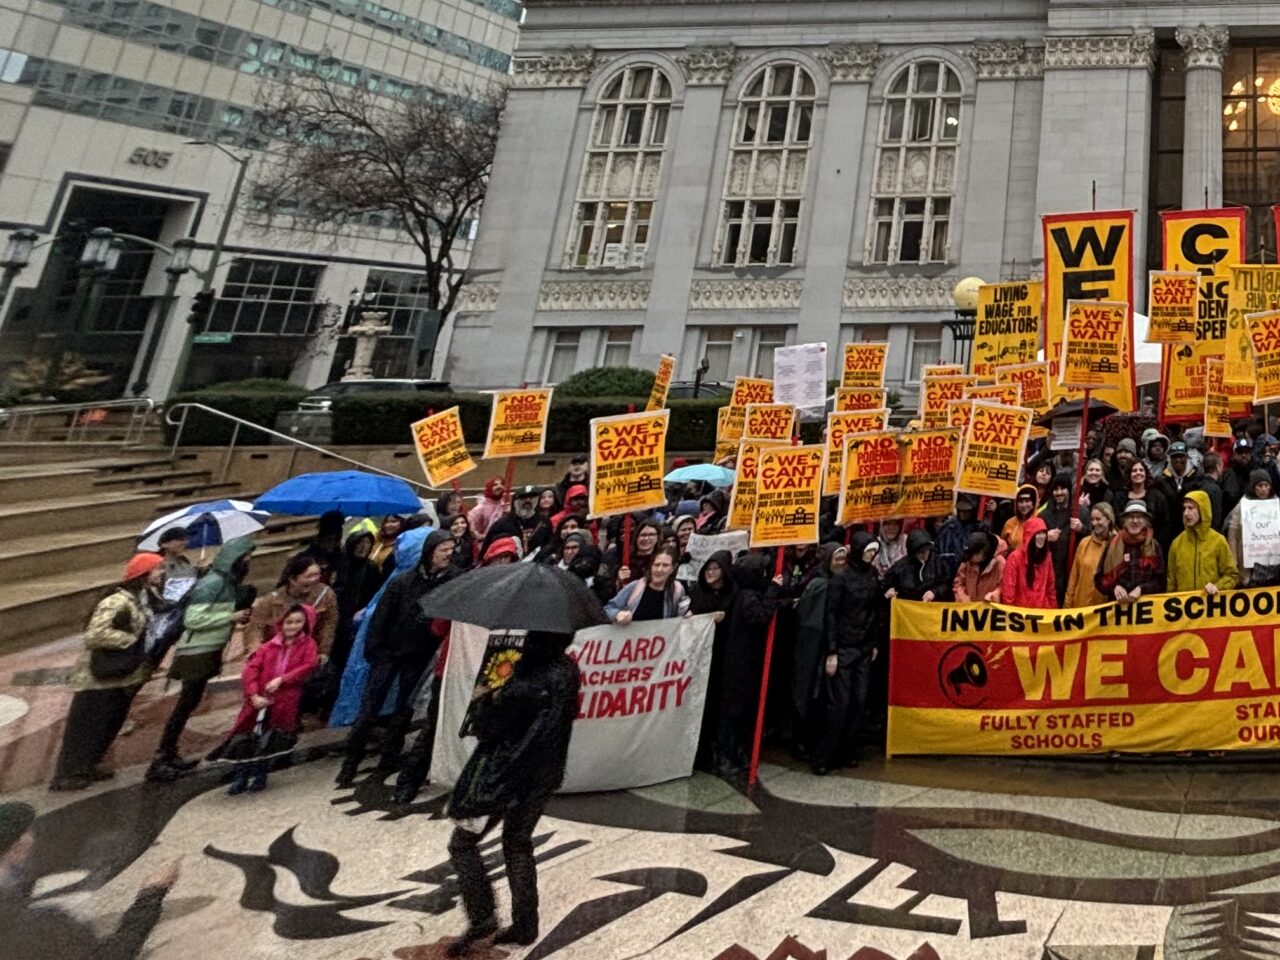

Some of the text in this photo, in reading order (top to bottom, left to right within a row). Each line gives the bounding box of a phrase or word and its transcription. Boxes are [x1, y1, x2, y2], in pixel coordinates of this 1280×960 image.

[129, 146, 173, 169] 505
[1163, 280, 1186, 288] WE
[994, 285, 1028, 303] LIVING
[1154, 296, 1192, 304] WAIT
[985, 302, 1032, 319] WAGE FOR
[1084, 310, 1111, 320] WE
[979, 316, 1038, 335] EDUCATORS
[1071, 330, 1117, 340] WAIT
[1011, 370, 1035, 382] NO
[745, 383, 768, 392] WE
[939, 383, 962, 391] WE
[511, 395, 536, 403] NO
[850, 393, 871, 402] NO
[760, 410, 782, 418] WE
[988, 412, 1015, 424] WE
[426, 416, 449, 430] WE
[845, 418, 872, 427] WE
[614, 423, 649, 437] WE
[750, 426, 786, 435] WAIT
[420, 430, 457, 449] WAIT
[864, 438, 892, 450] NO
[918, 436, 945, 448] NO
[973, 431, 1019, 446] WAIT
[599, 444, 658, 461] WAIT
[911, 445, 953, 459] PODEMOS
[777, 455, 808, 466] WE
[912, 459, 949, 474] ESPERAR
[763, 477, 814, 490] WAIT
[941, 608, 1043, 633] INVEST
[1052, 613, 1084, 631] IN
[1099, 599, 1153, 627] THE
[579, 660, 686, 686] ACHERS IN
[1011, 639, 1129, 701] WE
[577, 676, 692, 719] LIDARITY
[979, 711, 1135, 732] FULLY STAFFED
[1238, 723, 1280, 741] OUR
[1011, 732, 1103, 750] SCHOOLS
